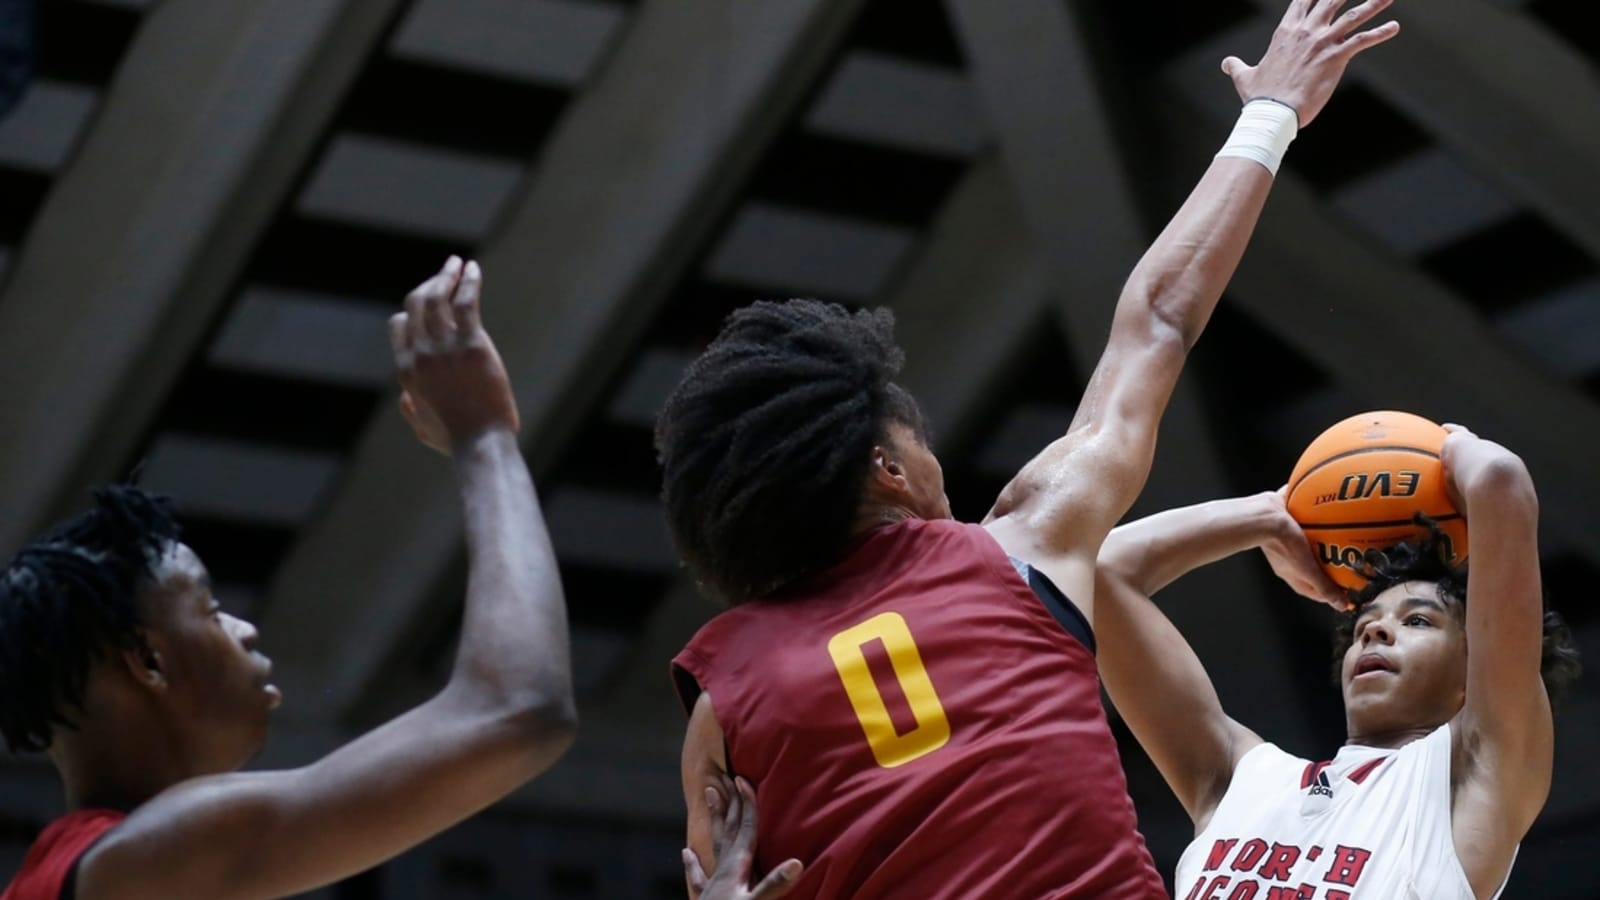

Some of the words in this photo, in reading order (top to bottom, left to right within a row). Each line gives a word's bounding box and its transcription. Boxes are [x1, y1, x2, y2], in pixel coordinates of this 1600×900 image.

[1314, 493, 1336, 506] NXT
[1338, 471, 1420, 501] EVO
[827, 611, 951, 769] 0
[1203, 838, 1372, 887] NORH
